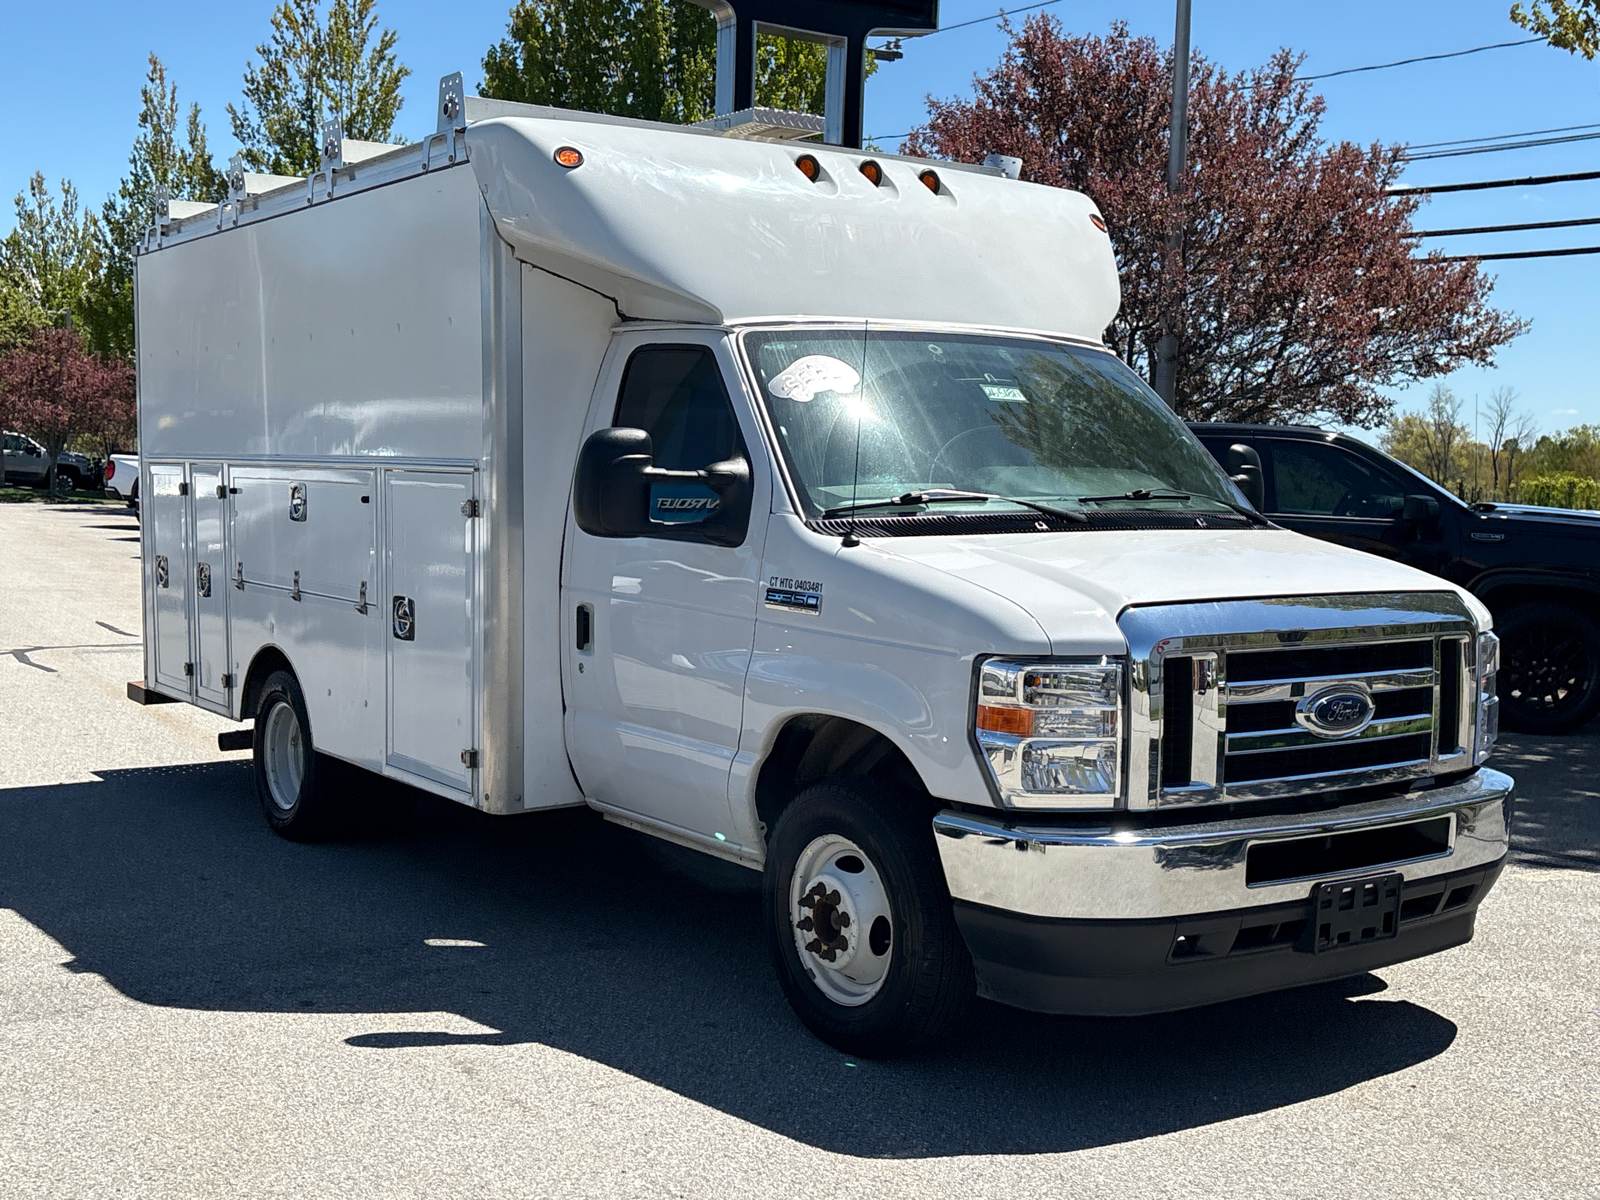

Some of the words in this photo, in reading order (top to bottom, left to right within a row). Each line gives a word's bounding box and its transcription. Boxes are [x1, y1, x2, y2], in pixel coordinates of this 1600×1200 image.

[769, 576, 779, 587] CT
[780, 577, 794, 590] HTG
[794, 579, 823, 593] 0403481
[1327, 700, 1360, 721] Ford
